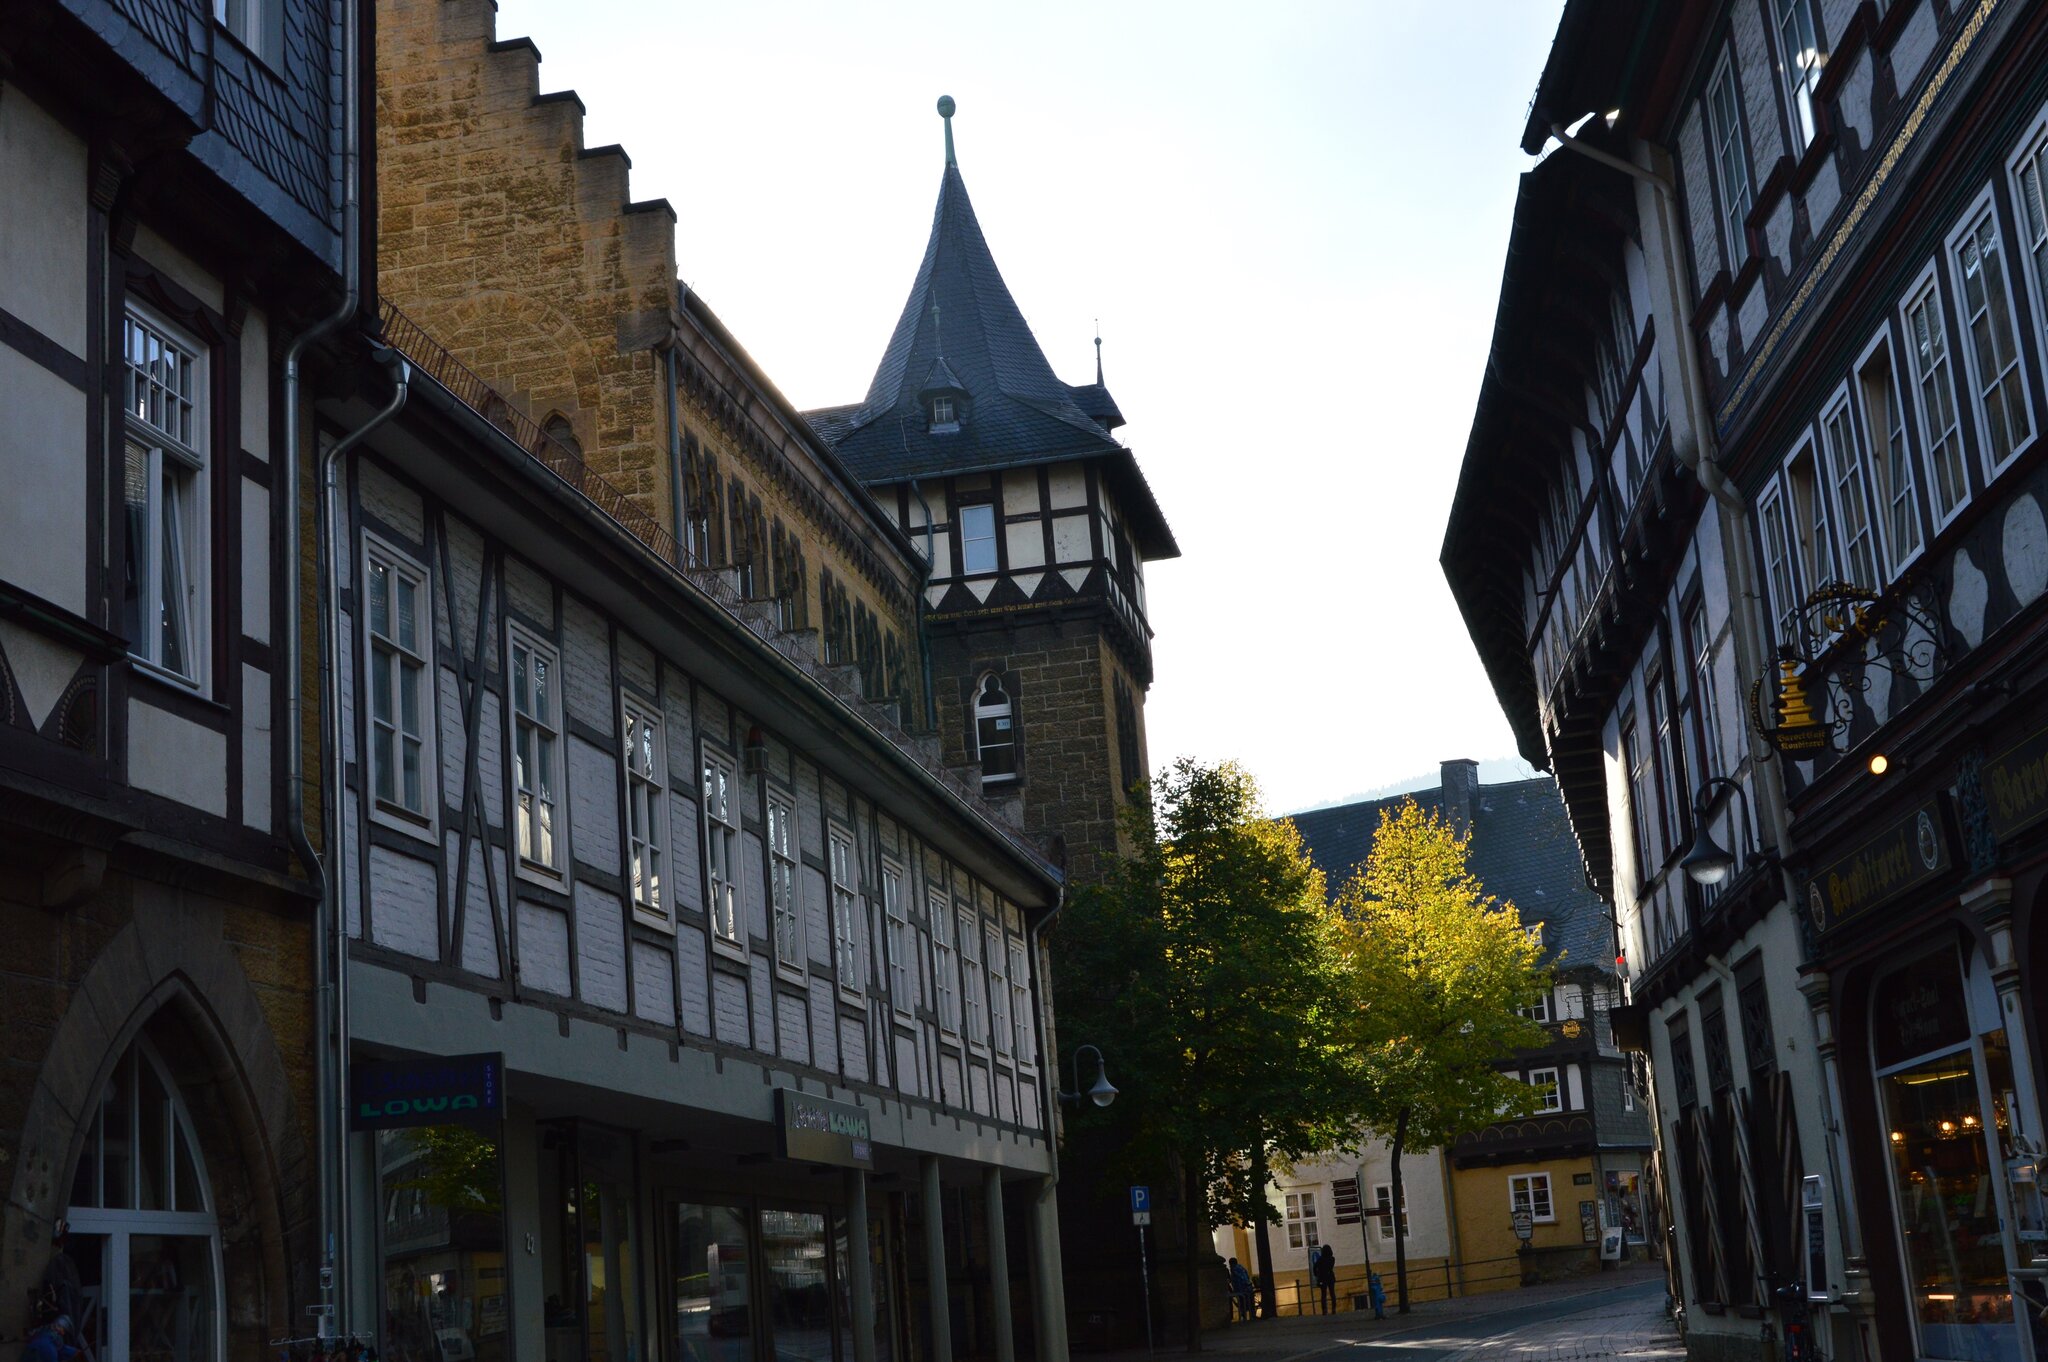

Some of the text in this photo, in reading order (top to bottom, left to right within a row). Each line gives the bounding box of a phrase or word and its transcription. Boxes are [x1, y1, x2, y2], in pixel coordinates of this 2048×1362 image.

[1829, 829, 1911, 916] Konditorei
[360, 1094, 478, 1118] LOWA
[829, 1111, 868, 1139] LOWA
[1135, 1189, 1145, 1208] P
[526, 1232, 535, 1254] 22
